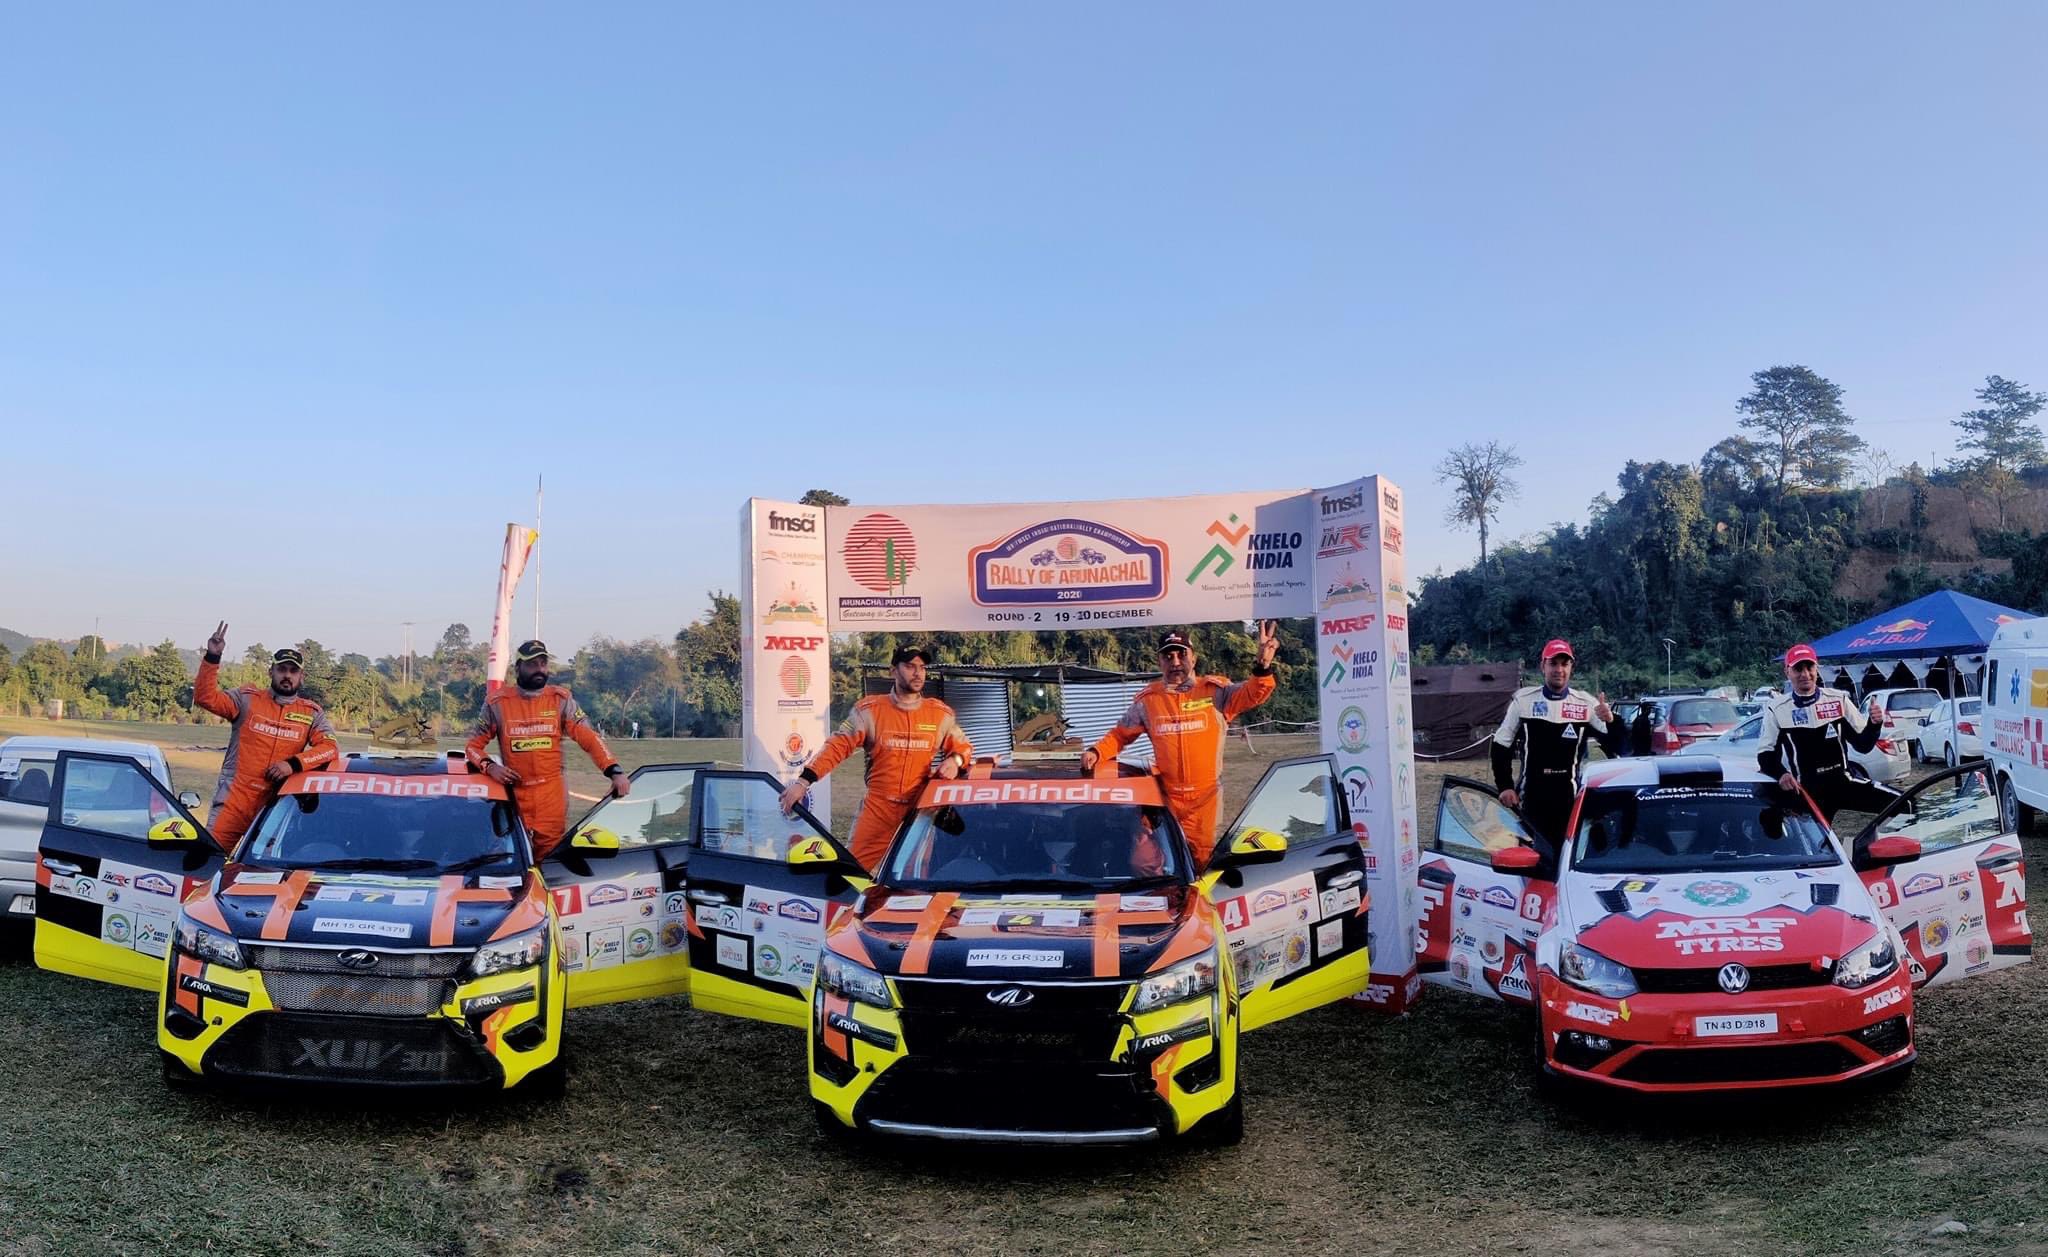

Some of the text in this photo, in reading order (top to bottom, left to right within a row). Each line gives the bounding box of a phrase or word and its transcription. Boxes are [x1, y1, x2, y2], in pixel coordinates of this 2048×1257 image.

[768, 510, 816, 533] fmsci
[1248, 532, 1303, 550] KHELO
[1246, 552, 1293, 570] INDIA
[990, 560, 1148, 586] RALLY OF ARUNACHAL
[987, 613, 1025, 622] ROUND
[1034, 612, 1042, 623] 2
[1055, 612, 1070, 622] 19
[1093, 608, 1154, 620] DECEMBER
[1321, 614, 1376, 635] MRF
[764, 636, 824, 651] MRF
[1847, 631, 1928, 648] Red Bull
[556, 888, 571, 914] 7
[1870, 881, 1892, 908] 8
[1223, 900, 1244, 928] 4
[1523, 893, 1542, 920] 8
[320, 920, 340, 929] MH
[358, 923, 376, 931] GR
[378, 924, 406, 934] 4379
[1655, 917, 1798, 939] MRF
[1674, 935, 1785, 955] TYRES
[969, 952, 991, 961] MH
[1011, 953, 1031, 962] GR
[190, 980, 212, 993] ARKA
[1501, 975, 1532, 992] ARKA
[837, 1019, 861, 1033] ARKA
[1704, 1022, 1718, 1030] TN
[1720, 1021, 1732, 1029] 43
[1141, 1034, 1173, 1049] ARKA
[292, 1038, 403, 1070] XUV
